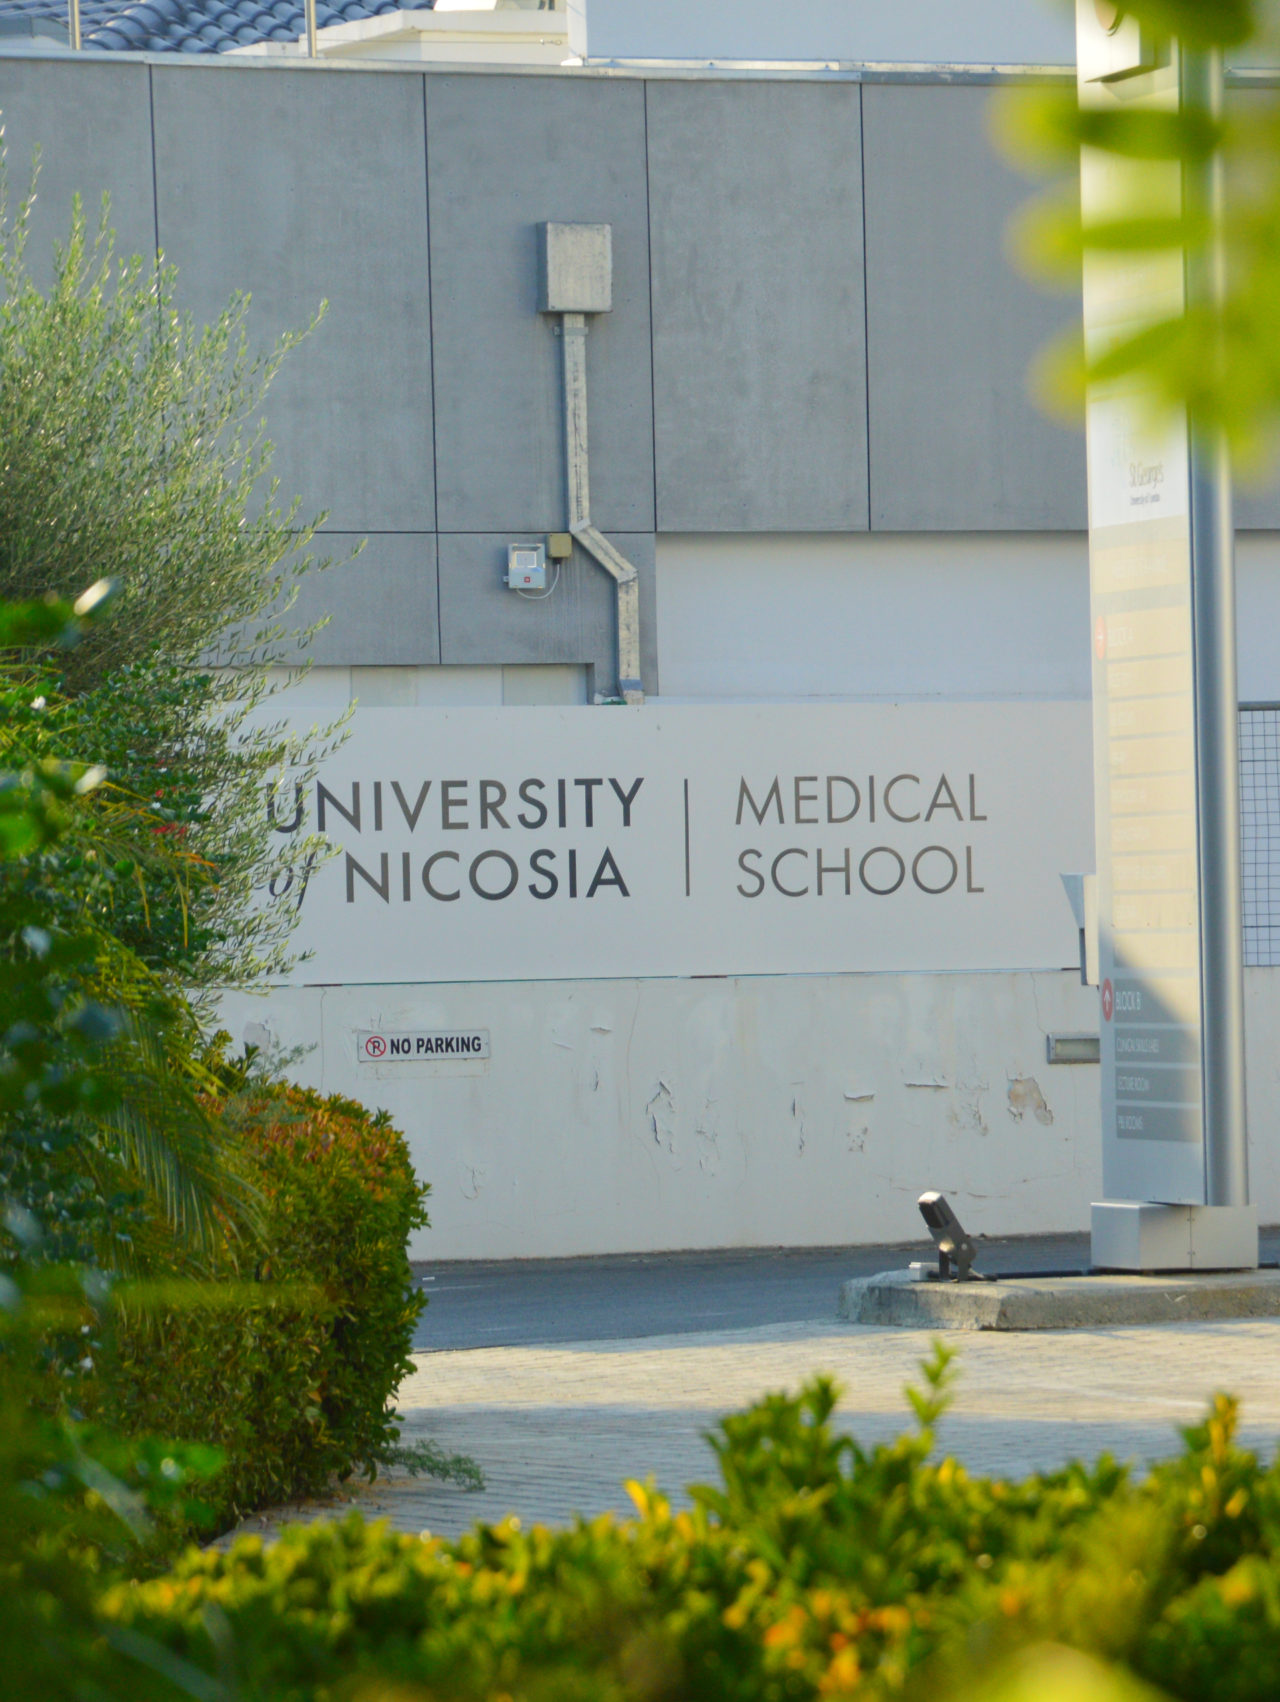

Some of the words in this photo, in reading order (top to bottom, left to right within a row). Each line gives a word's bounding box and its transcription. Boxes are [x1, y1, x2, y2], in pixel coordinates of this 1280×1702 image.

[266, 777, 645, 834] UNIVERSITY
[735, 772, 988, 826] MEDICAL
[268, 842, 332, 912] of
[345, 846, 631, 904] NICOSIA
[736, 845, 985, 898] SCHOOL
[1115, 991, 1135, 1010] BLOCK
[390, 1038, 412, 1055] NO
[416, 1036, 482, 1054] PARKING
